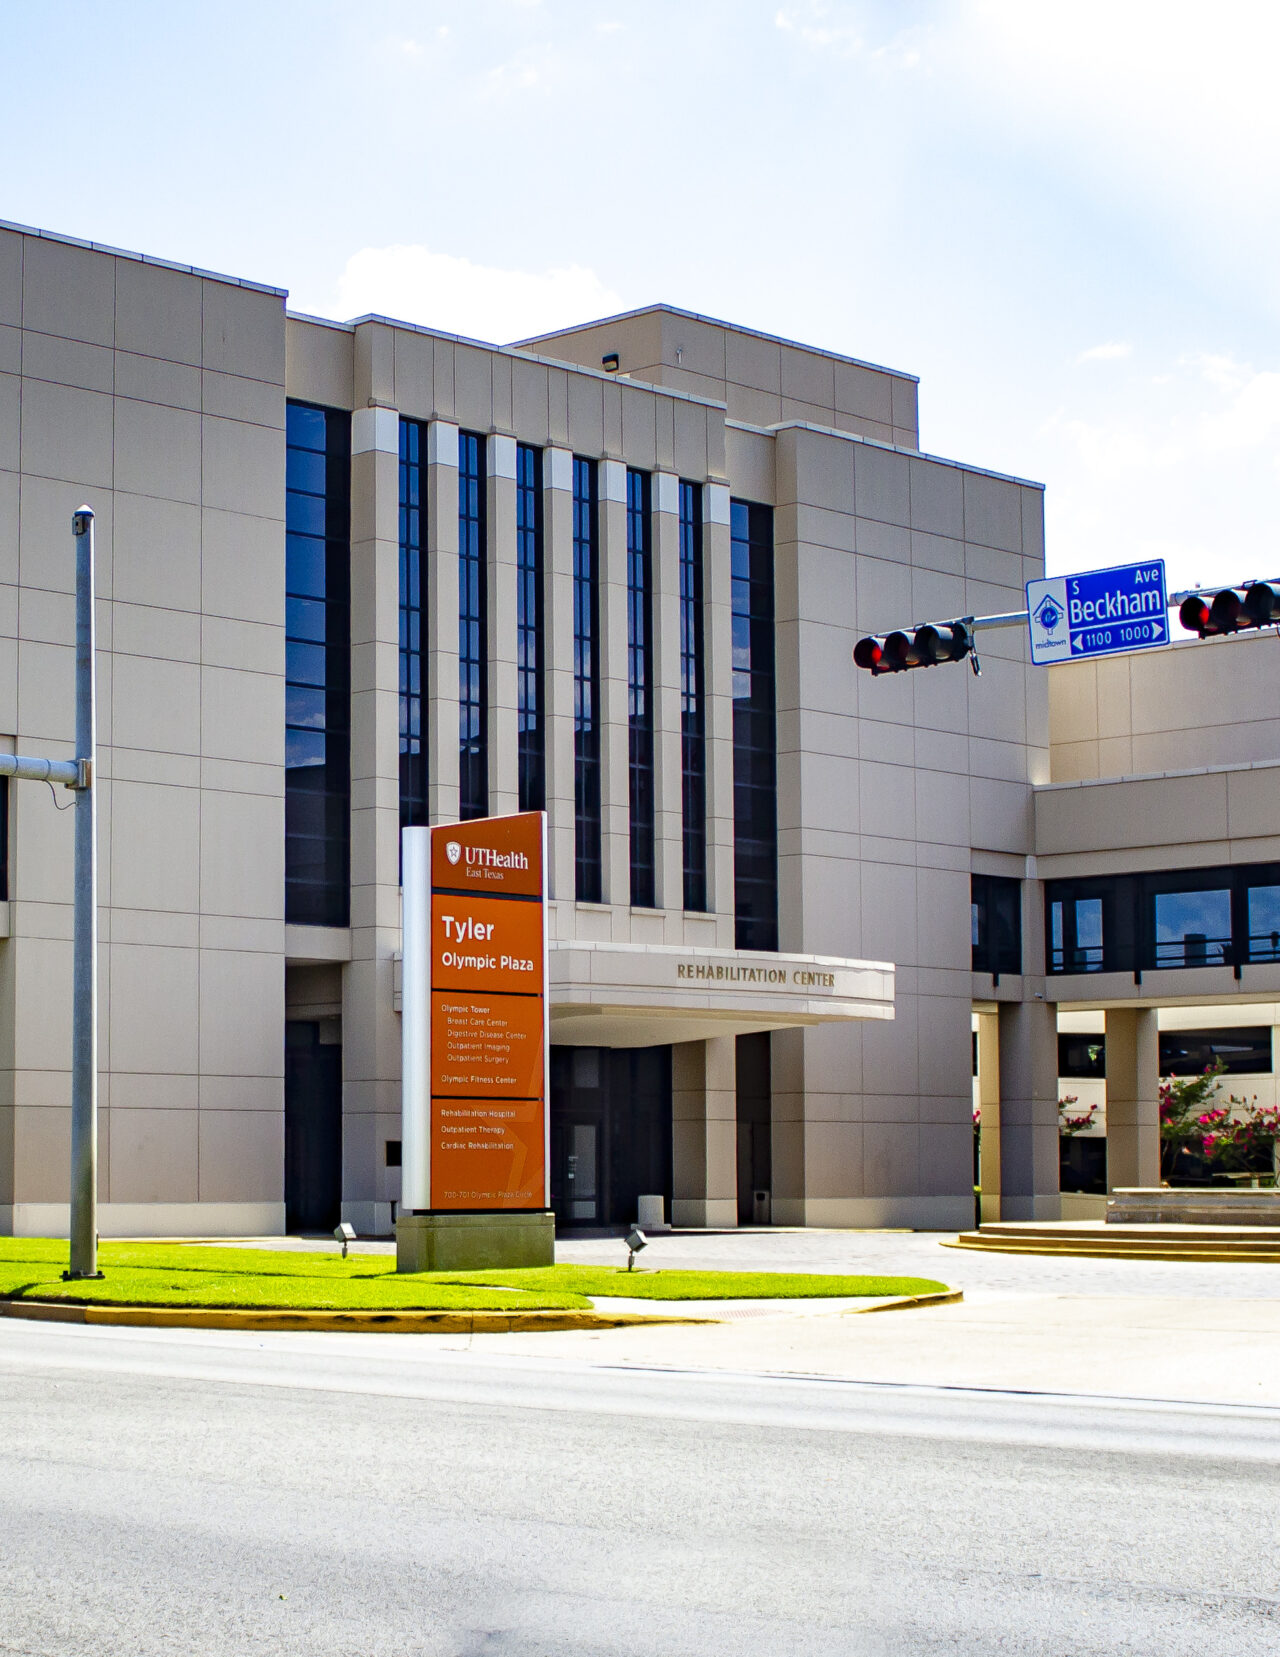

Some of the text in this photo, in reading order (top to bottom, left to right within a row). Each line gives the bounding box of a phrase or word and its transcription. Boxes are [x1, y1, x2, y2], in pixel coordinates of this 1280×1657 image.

[1134, 569, 1159, 585] Ave
[1072, 580, 1080, 595] S
[1070, 589, 1161, 624] Beckham
[1086, 631, 1112, 647] 1100
[1120, 625, 1150, 642] 1000
[1035, 639, 1067, 650] midtown
[465, 846, 529, 870] UTHealth
[466, 867, 504, 880] East Texas
[441, 915, 495, 943] Tyler
[441, 952, 534, 971] Olympic Plaza
[677, 964, 835, 987] REHABILITATION CENTER
[441, 1004, 490, 1014] Olympic Tower
[447, 1017, 508, 1027] Breast Care Center
[447, 1029, 527, 1040] Digestive Disease Center
[447, 1041, 510, 1052] Outpatient Imaging
[447, 1054, 509, 1064] Outpatient Surgery
[441, 1074, 517, 1084] Olympic Fitness Center
[489, 1110, 516, 1119] Hospital
[441, 1125, 505, 1135] Outpatient Therapy
[441, 1142, 466, 1150] Cardiac
